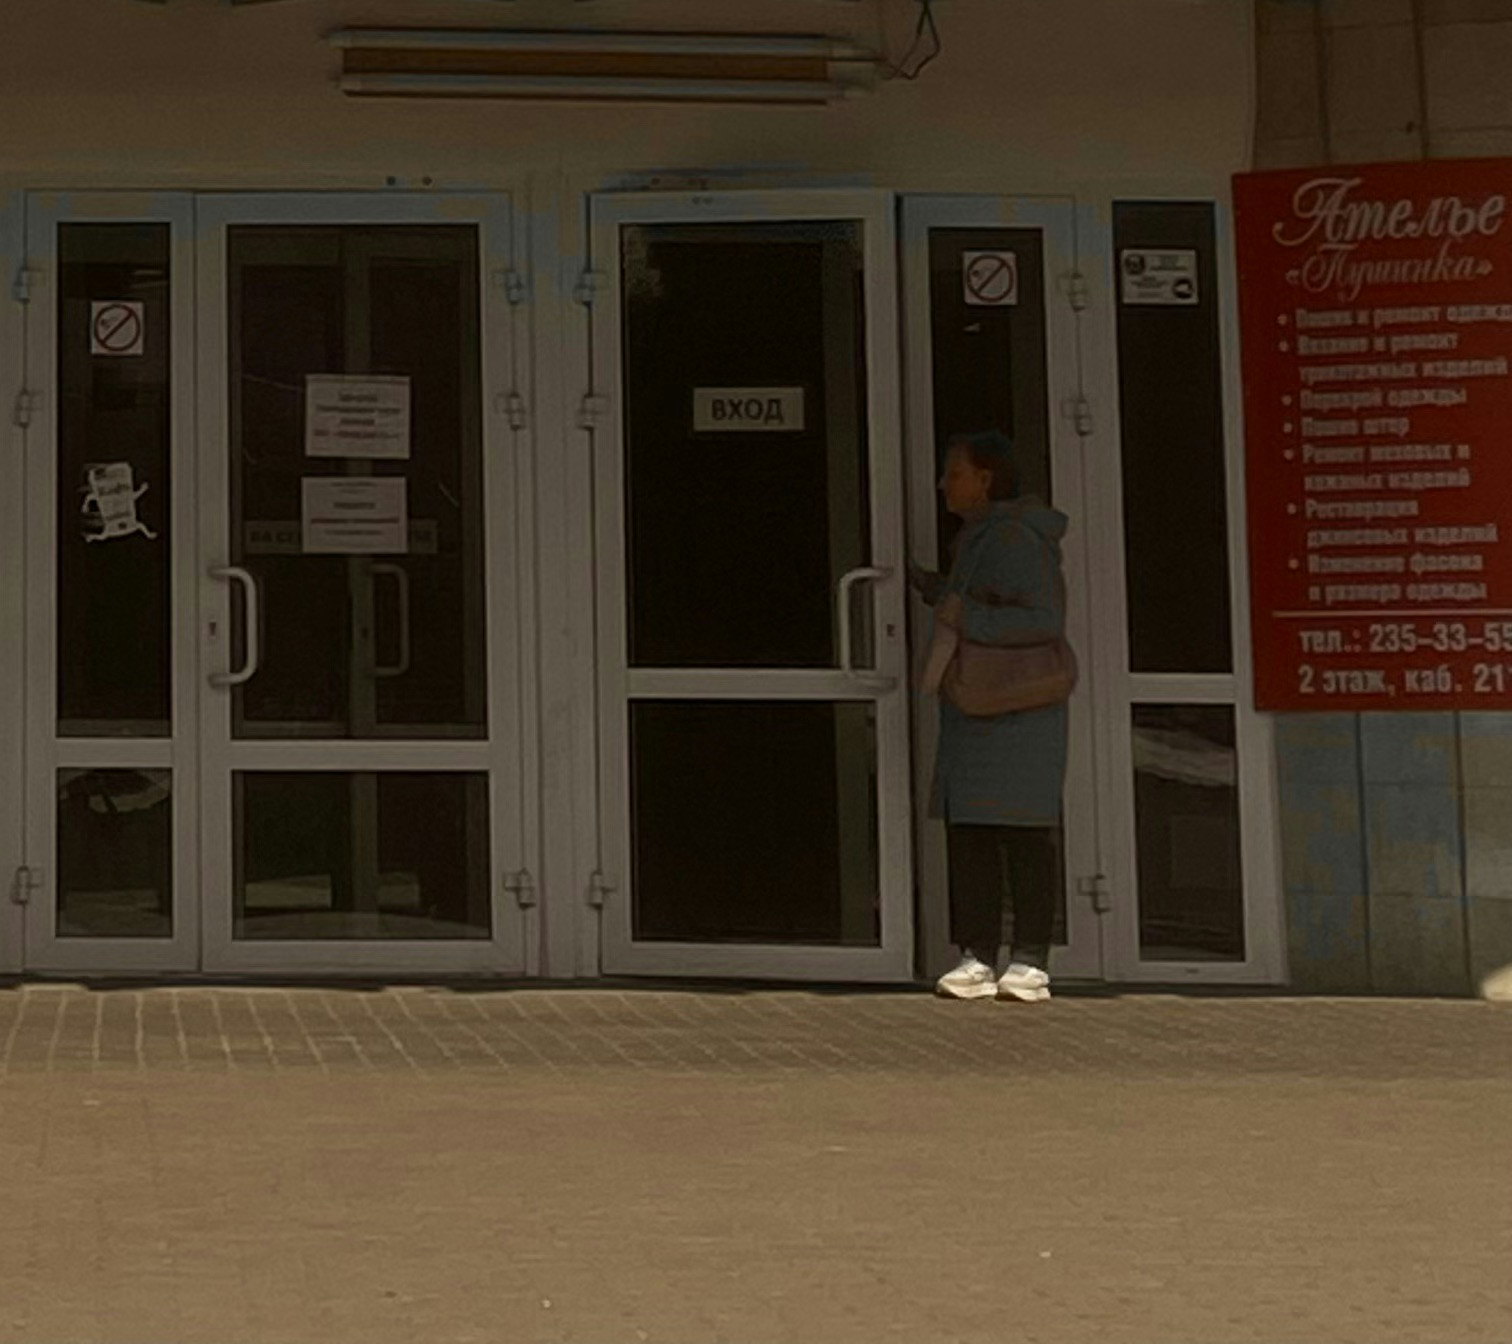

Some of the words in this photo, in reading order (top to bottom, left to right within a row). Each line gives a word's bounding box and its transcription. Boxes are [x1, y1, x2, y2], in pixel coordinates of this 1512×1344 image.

[1272, 176, 1506, 246] Ателье
[711, 398, 785, 425] ВХОД
[1298, 663, 1316, 695] 2
[1404, 663, 1464, 694] каб.
